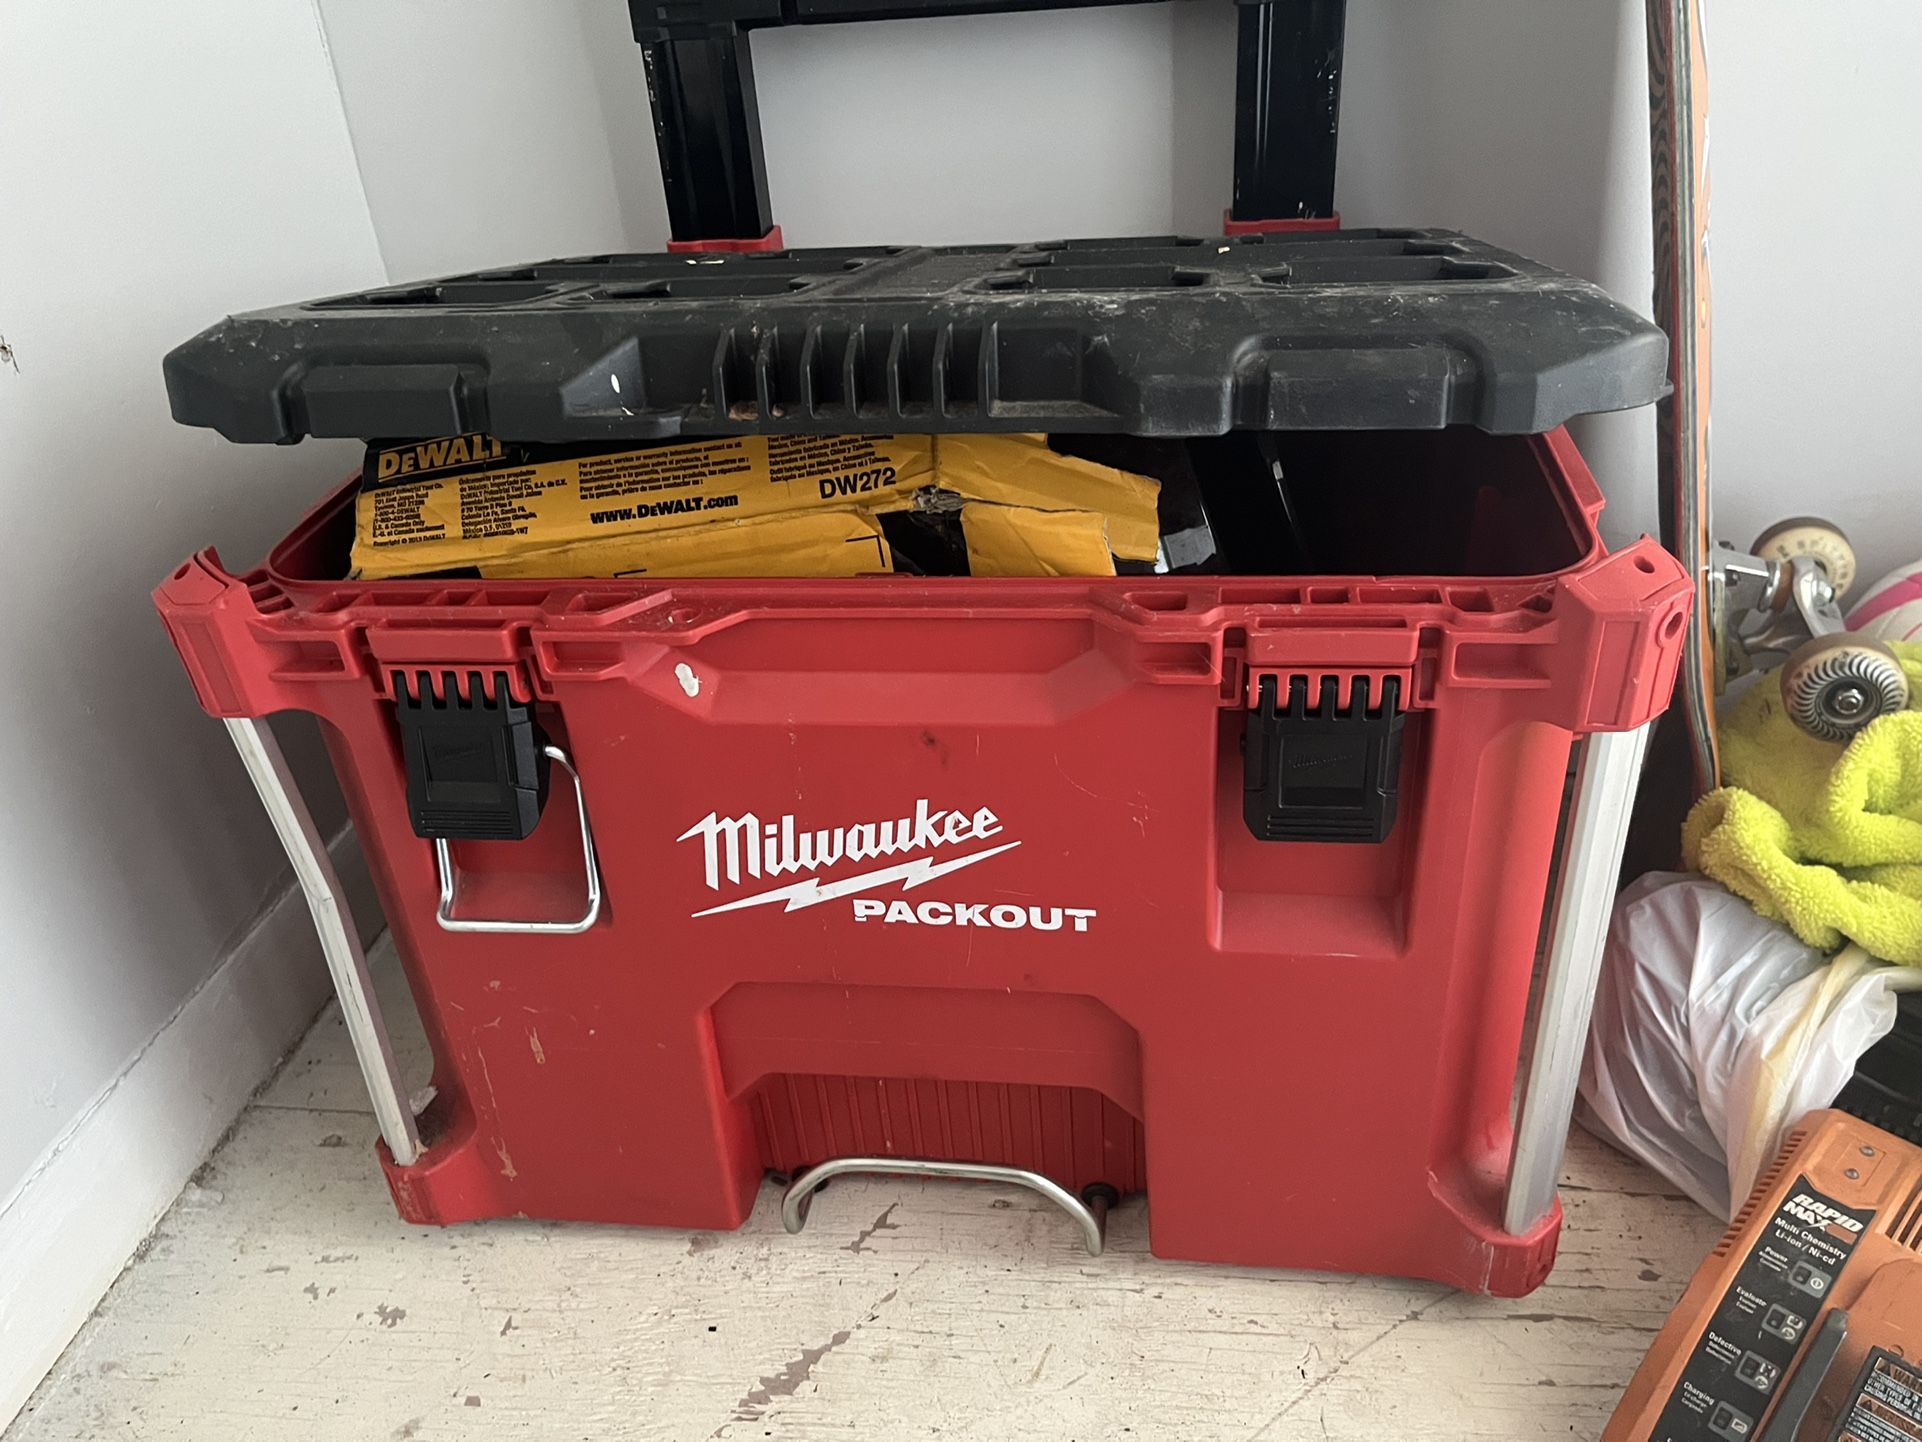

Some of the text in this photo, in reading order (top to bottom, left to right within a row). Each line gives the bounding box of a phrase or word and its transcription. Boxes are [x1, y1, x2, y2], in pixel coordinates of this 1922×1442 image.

[819, 467, 897, 499] DW272
[676, 799, 1003, 891] Milwaukee
[853, 898, 1097, 932] PACKOUT
[1782, 1200, 1832, 1232] MAX
[1792, 1193, 1864, 1232] RAPID
[1764, 1246, 1788, 1262] Power
[1774, 1217, 1800, 1235] Multi
[1801, 1231, 1847, 1260] Chemistry
[1775, 1229, 1802, 1248] Li-ion
[1808, 1246, 1836, 1265] Ni-cd
[1736, 1286, 1767, 1307] Evaluate
[1708, 1331, 1742, 1356] Defective
[1683, 1381, 1715, 1406] Charging
